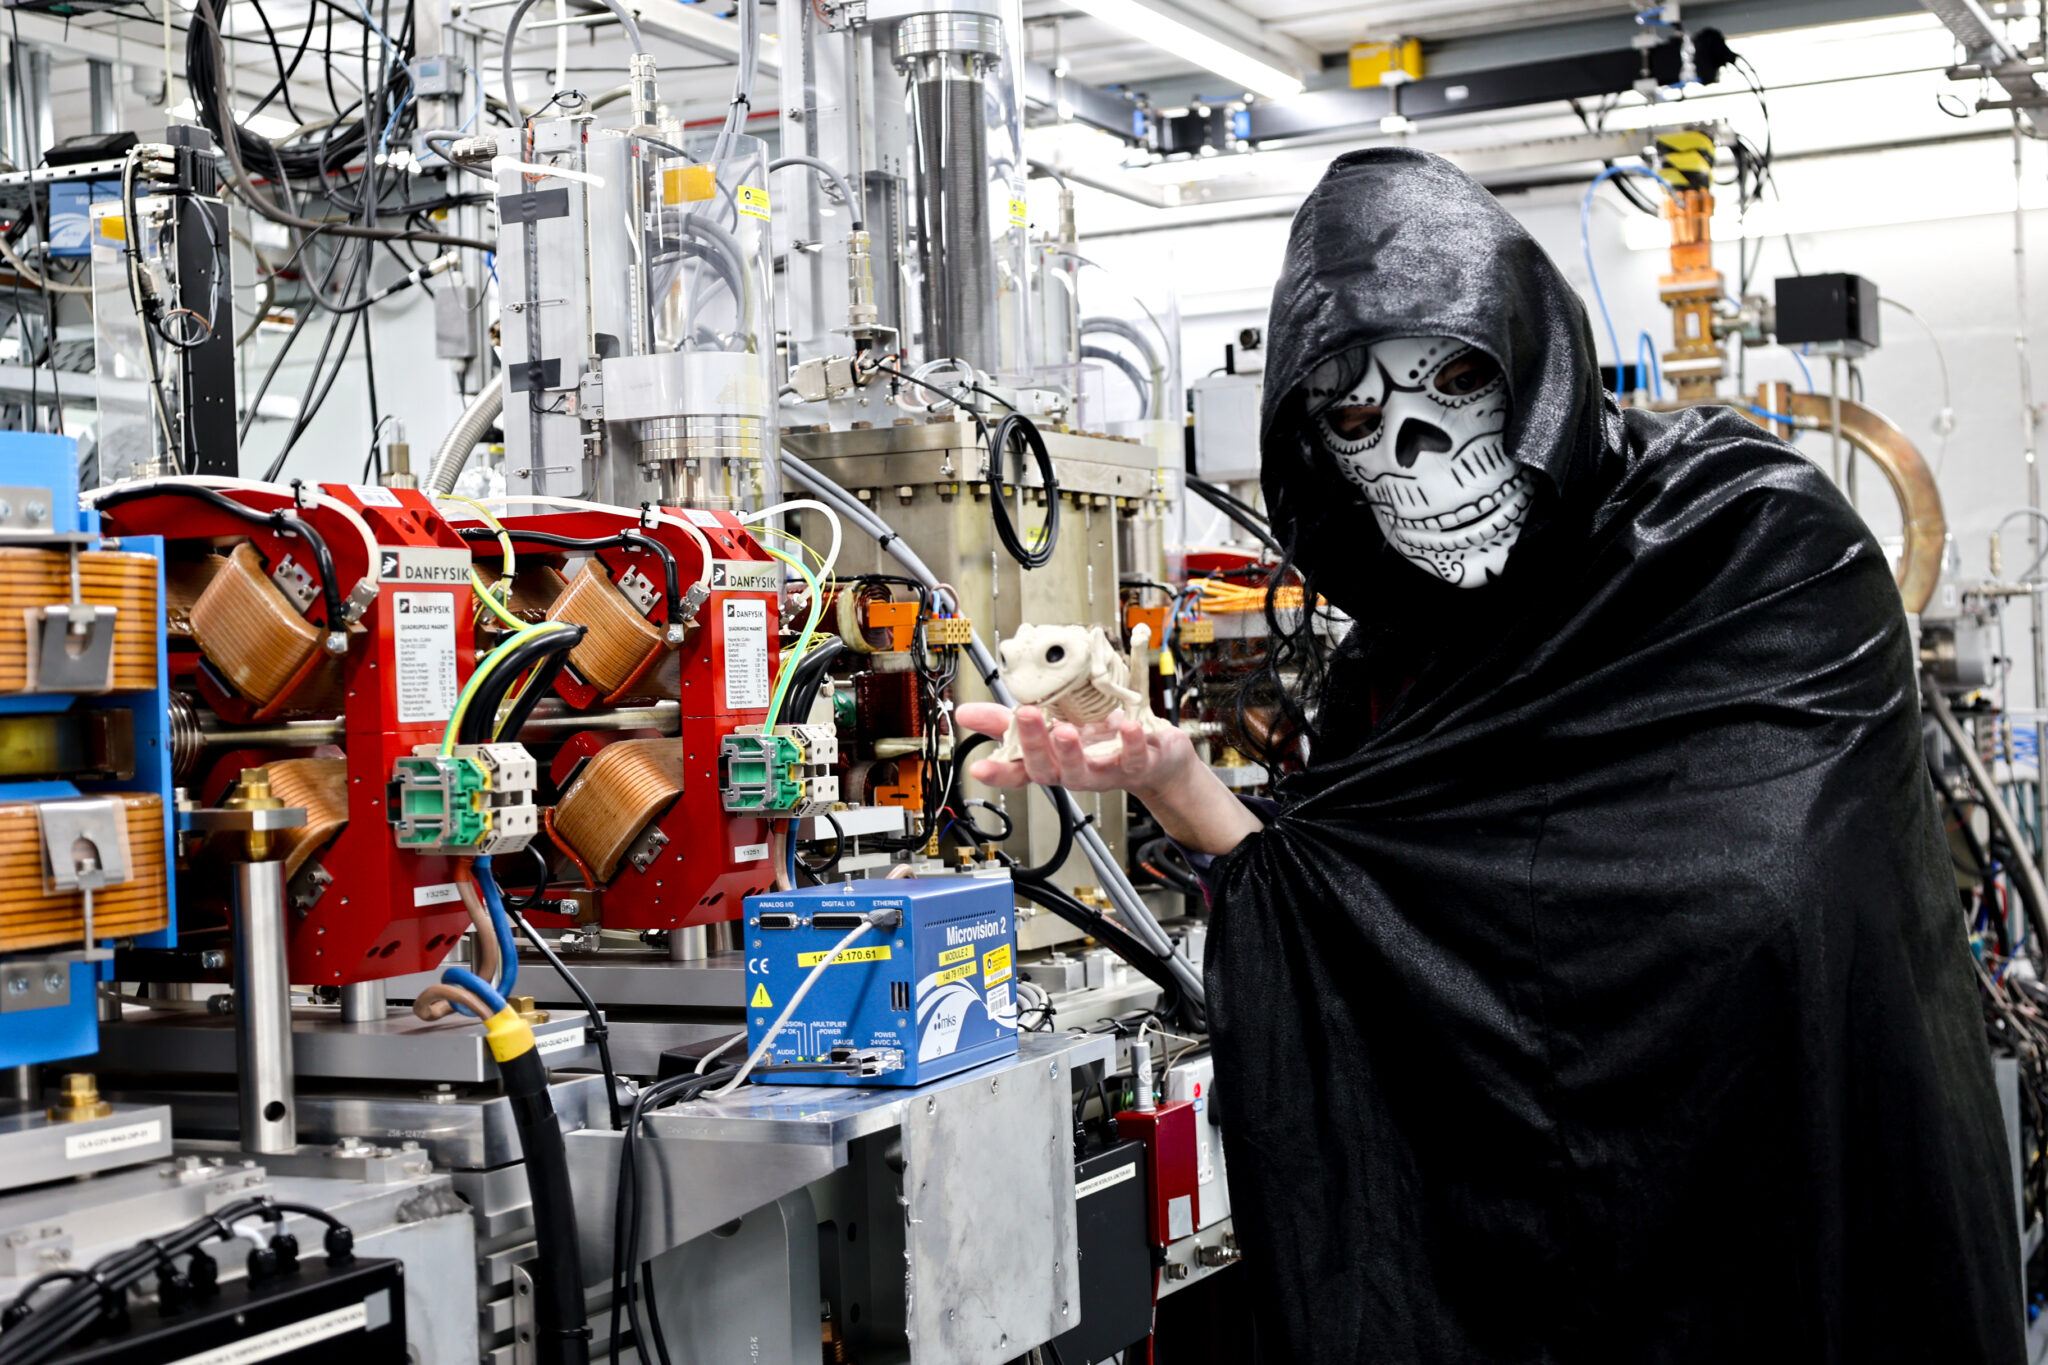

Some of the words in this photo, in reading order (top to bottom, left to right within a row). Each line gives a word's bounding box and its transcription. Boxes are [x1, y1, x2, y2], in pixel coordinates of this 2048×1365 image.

[405, 566, 470, 581] DANFYSIK
[730, 575, 777, 589] DANFYSIK
[412, 605, 450, 614] DANFYSIK
[736, 610, 764, 618] DANFYSIK
[946, 919, 999, 946] Microvision
[1000, 916, 1007, 934] 2
